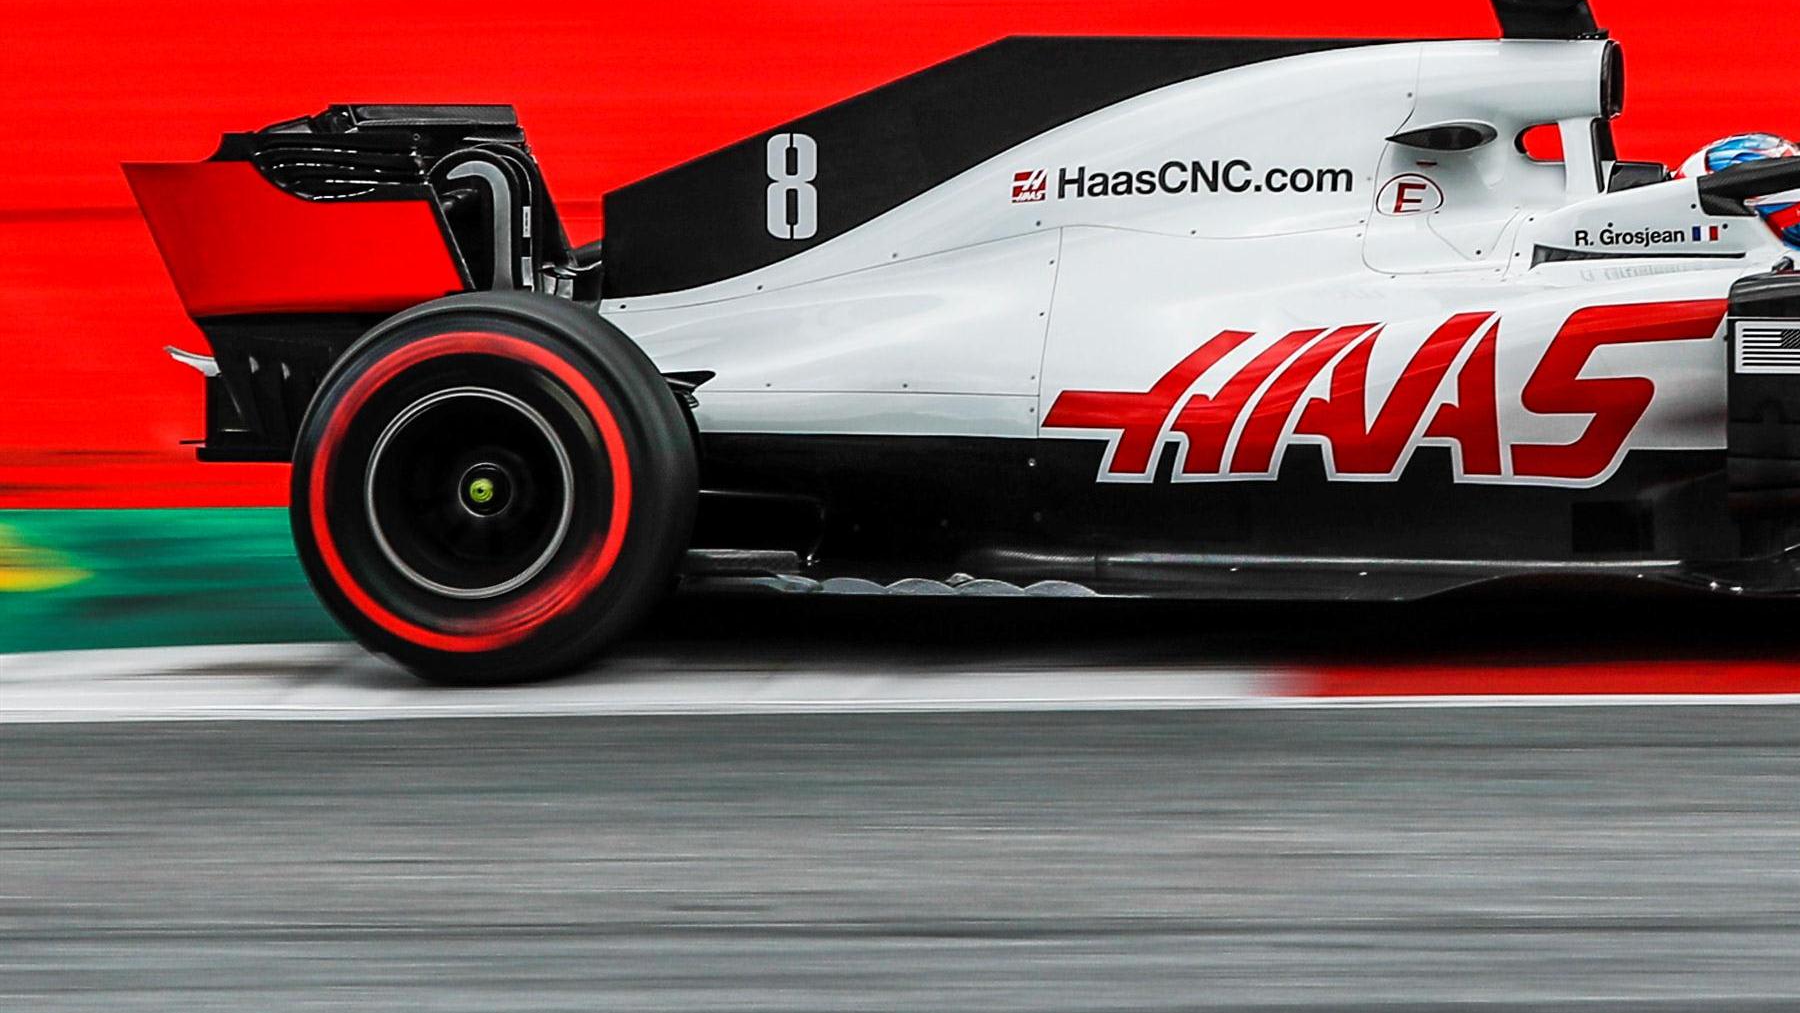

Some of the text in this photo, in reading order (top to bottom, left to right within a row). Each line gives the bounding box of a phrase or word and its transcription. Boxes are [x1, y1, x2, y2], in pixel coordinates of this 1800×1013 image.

[767, 133, 817, 239] 8
[1058, 160, 1352, 199] HaasCNC.com
[1393, 182, 1427, 213] E
[1575, 228, 1685, 248] R. Grosjean
[1040, 298, 1729, 482] HAAS
